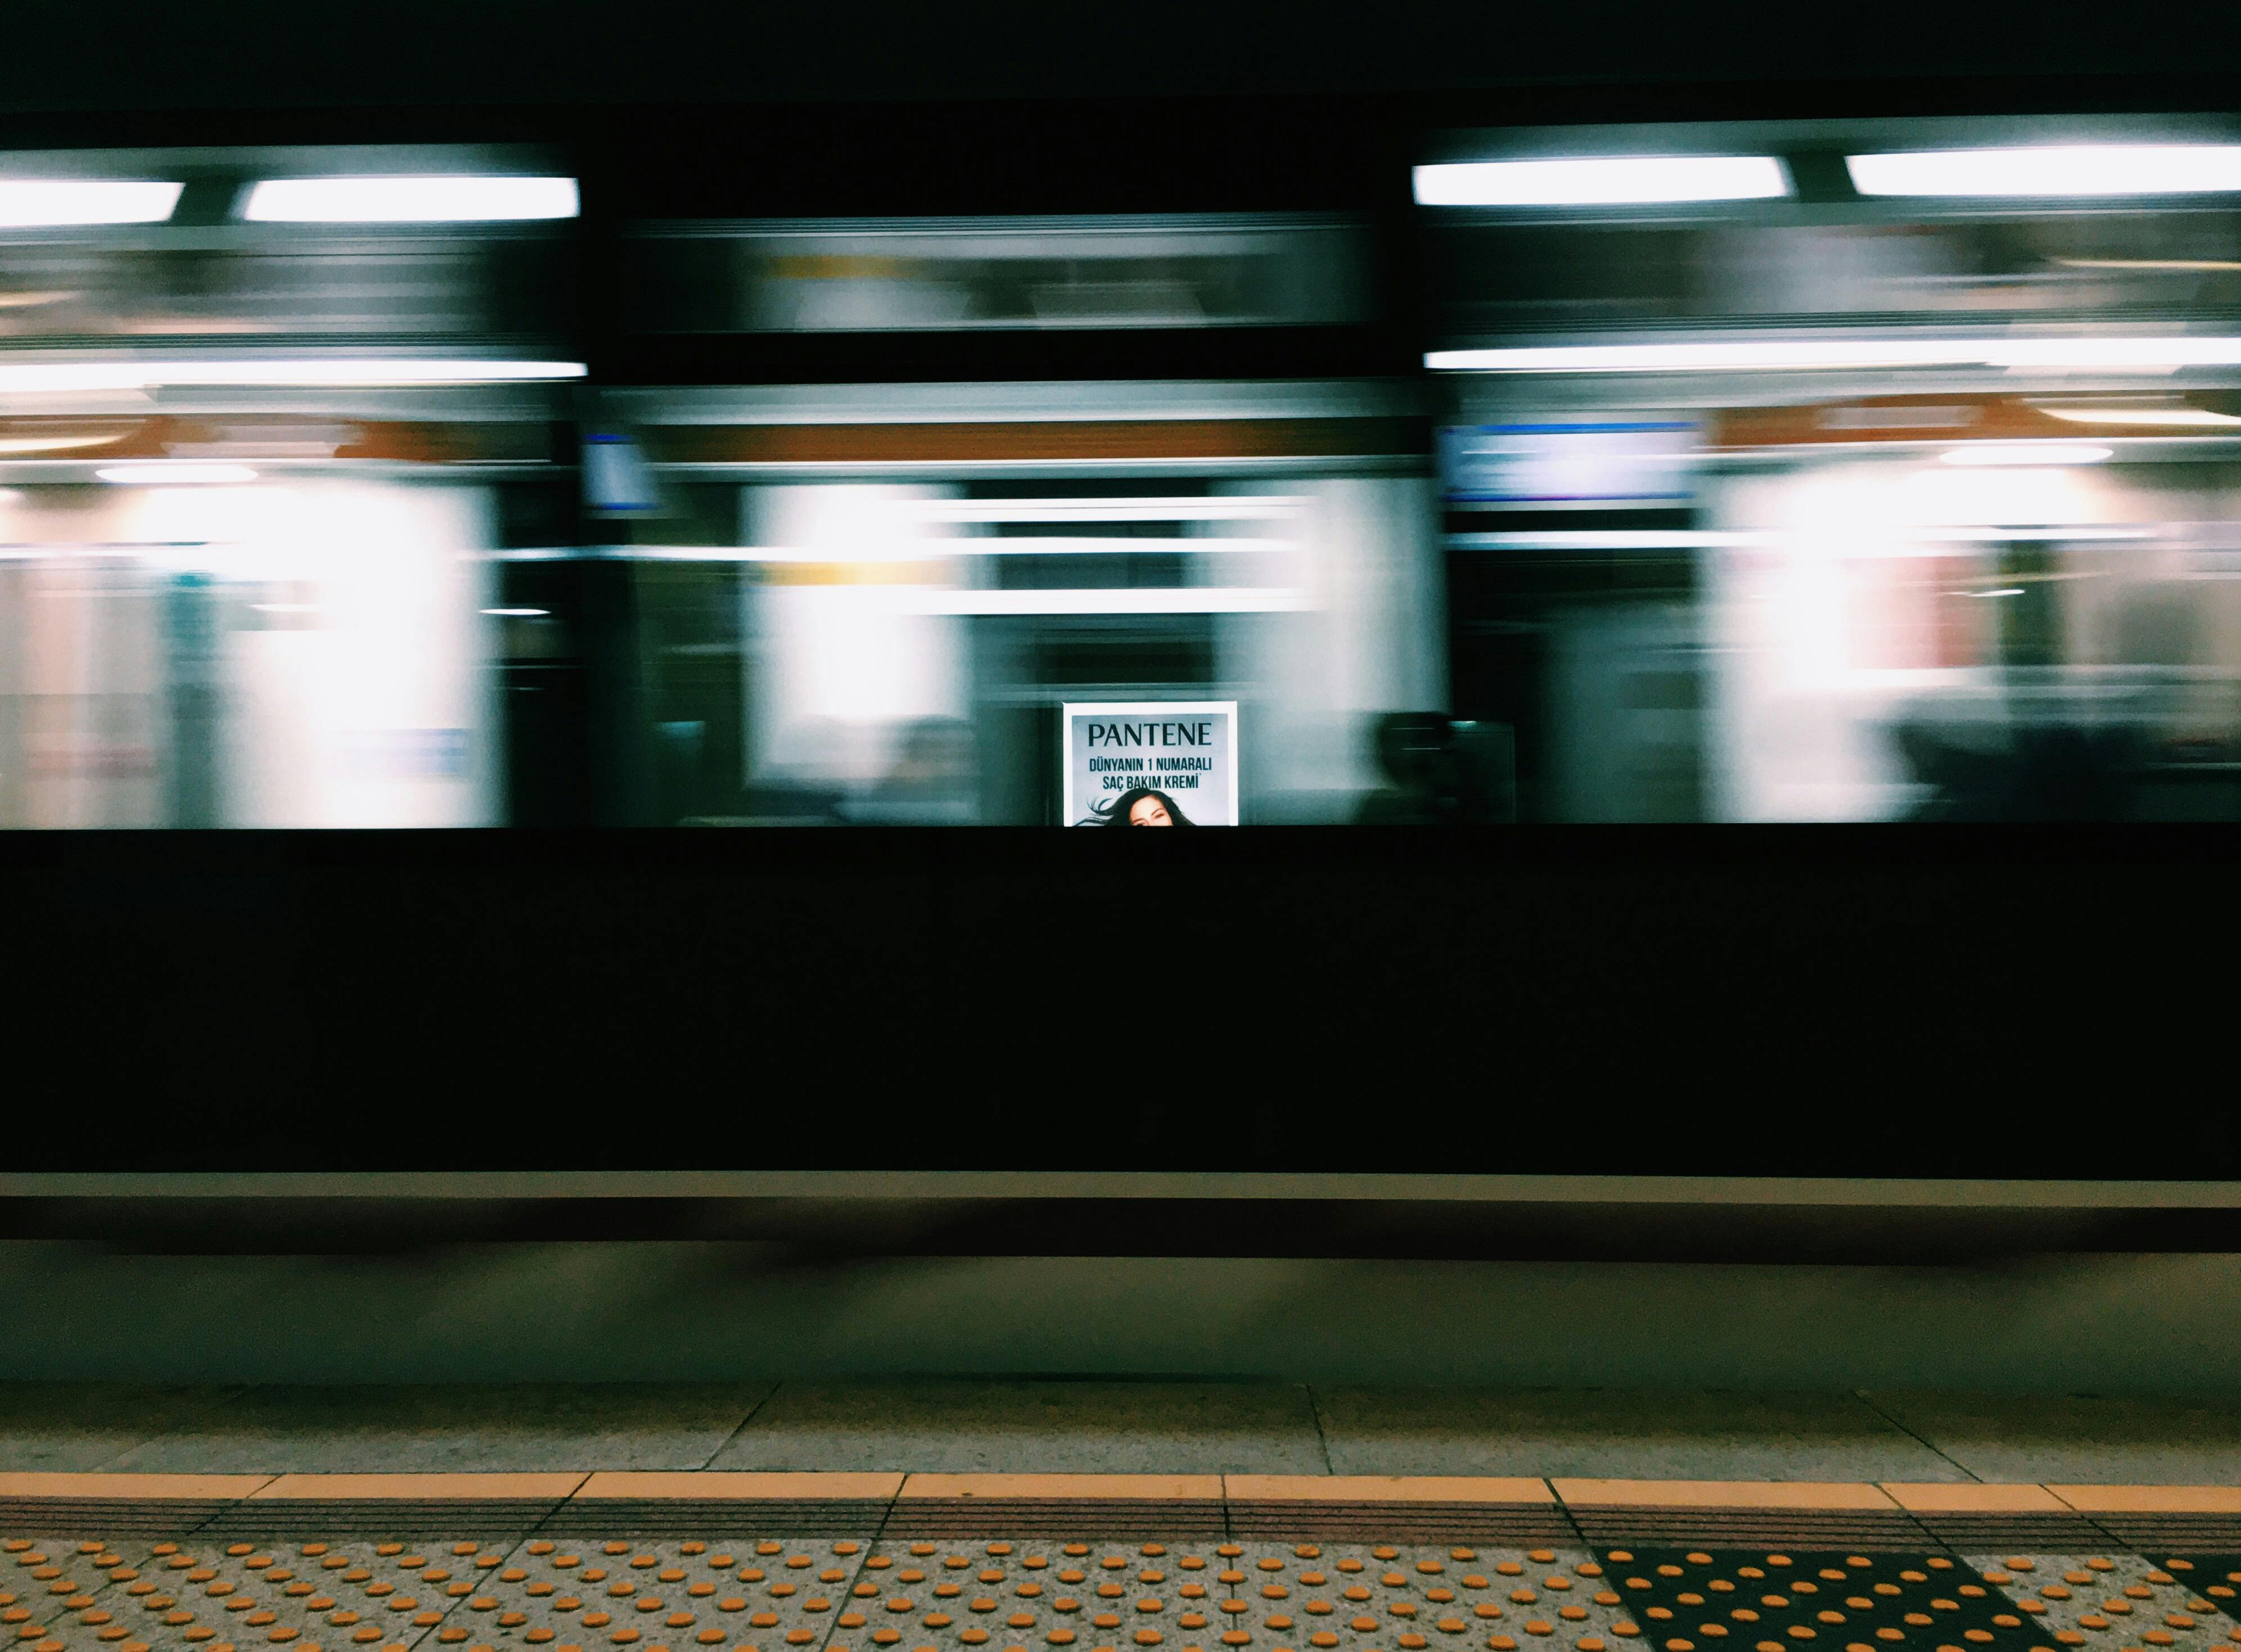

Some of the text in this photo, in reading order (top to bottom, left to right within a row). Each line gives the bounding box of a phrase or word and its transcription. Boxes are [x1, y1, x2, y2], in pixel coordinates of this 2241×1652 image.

[1088, 723, 1212, 747] PANTENE
[1089, 756, 1212, 771] DÜNYANIN 1 NUMARALI
[1103, 776, 1124, 791] SAÇ
[1126, 775, 1161, 789] BAKIM
